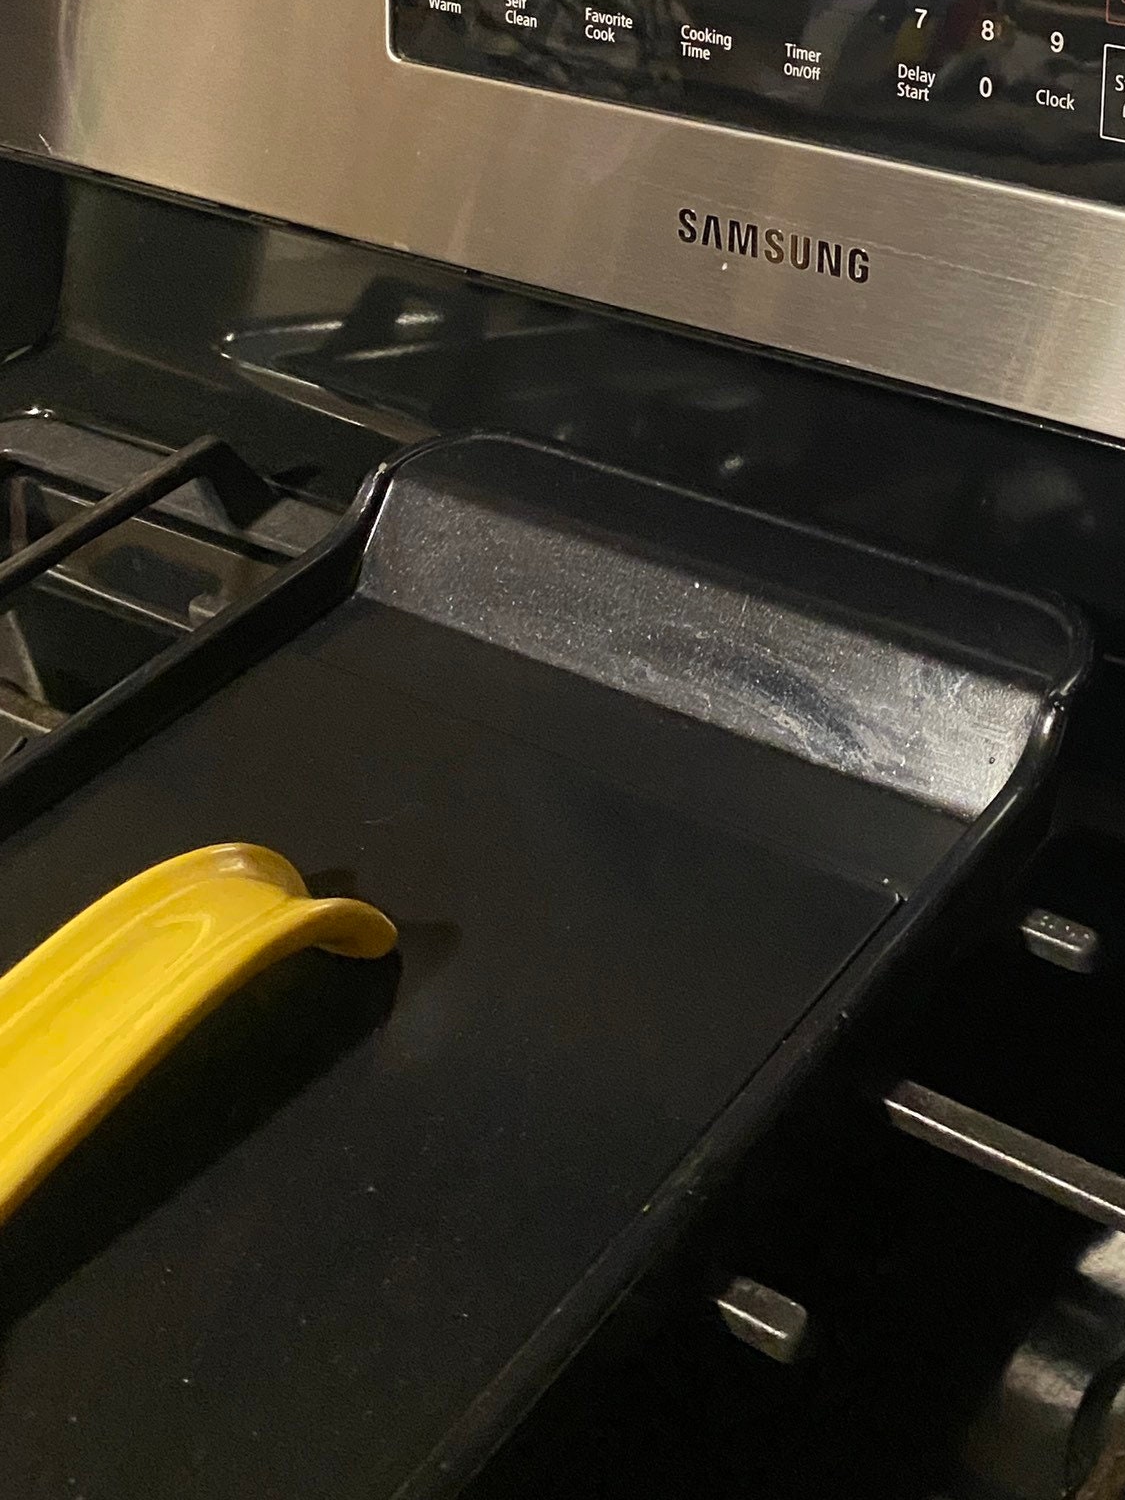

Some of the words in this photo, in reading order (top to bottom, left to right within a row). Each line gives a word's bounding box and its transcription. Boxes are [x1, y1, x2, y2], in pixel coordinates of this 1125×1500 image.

[505, 9, 538, 28] Clean
[585, 7, 634, 29] Favorite
[914, 8, 928, 29] 7
[585, 24, 616, 43] Cook
[680, 24, 732, 50] Cooking
[980, 19, 995, 41] 8
[680, 41, 711, 61] Time
[785, 42, 822, 64] Timer
[1050, 31, 1065, 54] 9
[784, 62, 821, 81] On/Off
[897, 63, 936, 87] Delay
[897, 82, 930, 102] Start
[979, 76, 993, 99] 0
[1035, 89, 1075, 111] Clock
[677, 208, 870, 284] SAMSUNG
